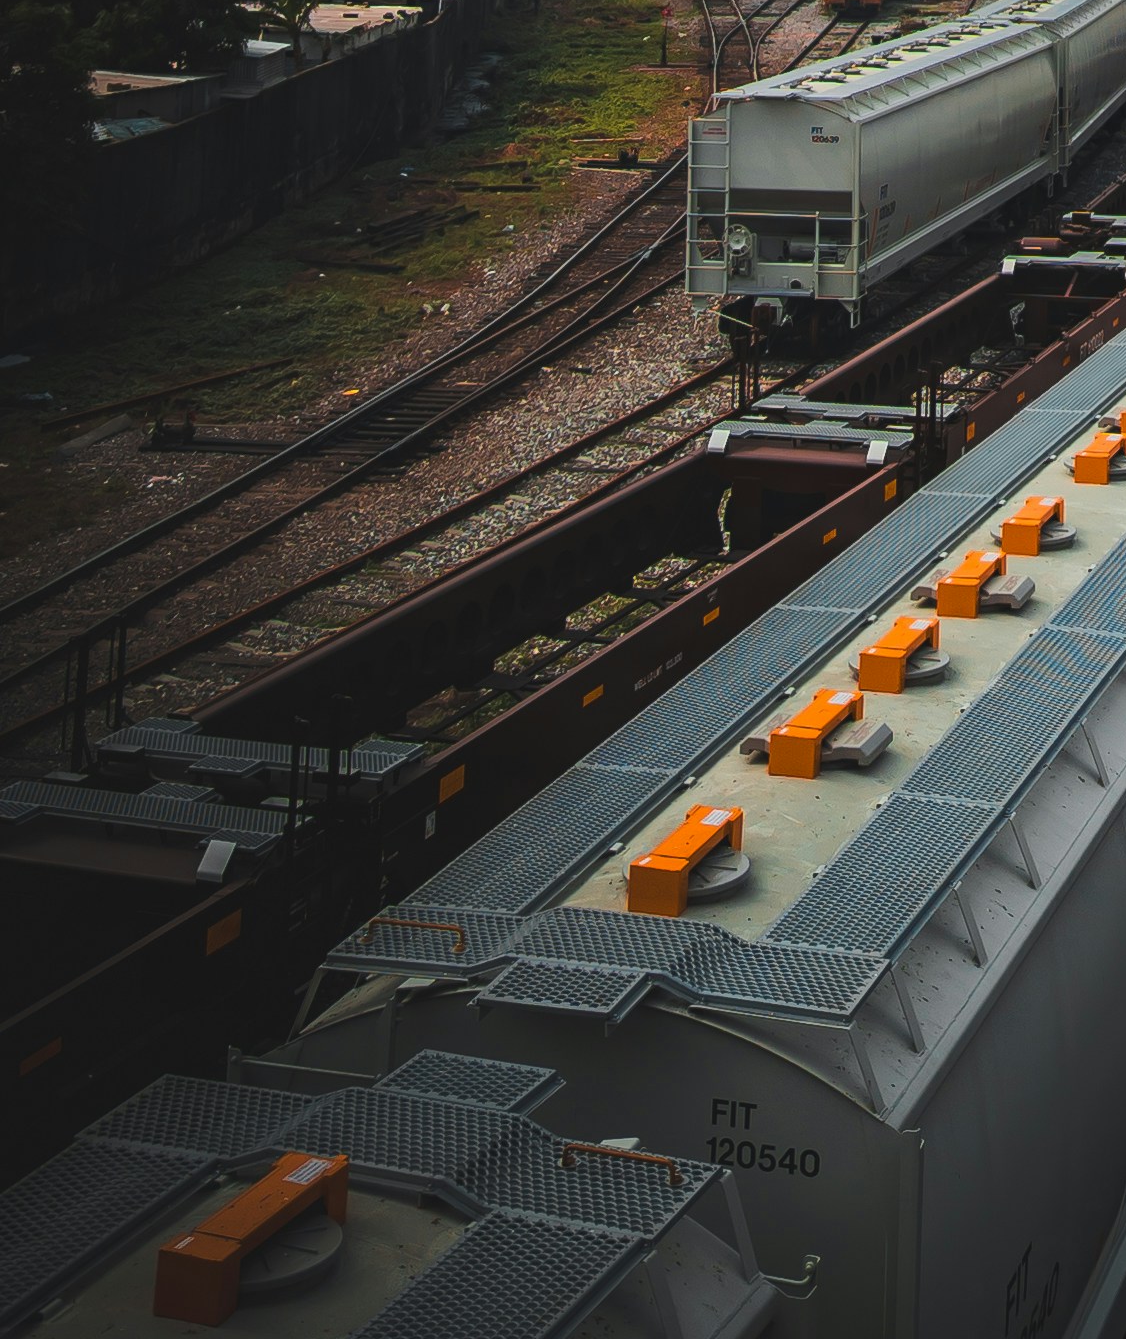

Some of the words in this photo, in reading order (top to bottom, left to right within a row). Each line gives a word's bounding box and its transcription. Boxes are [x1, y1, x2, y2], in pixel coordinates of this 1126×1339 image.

[711, 1098, 758, 1130] FIT
[706, 1136, 820, 1178] 120540
[1004, 1240, 1032, 1338] FIT
